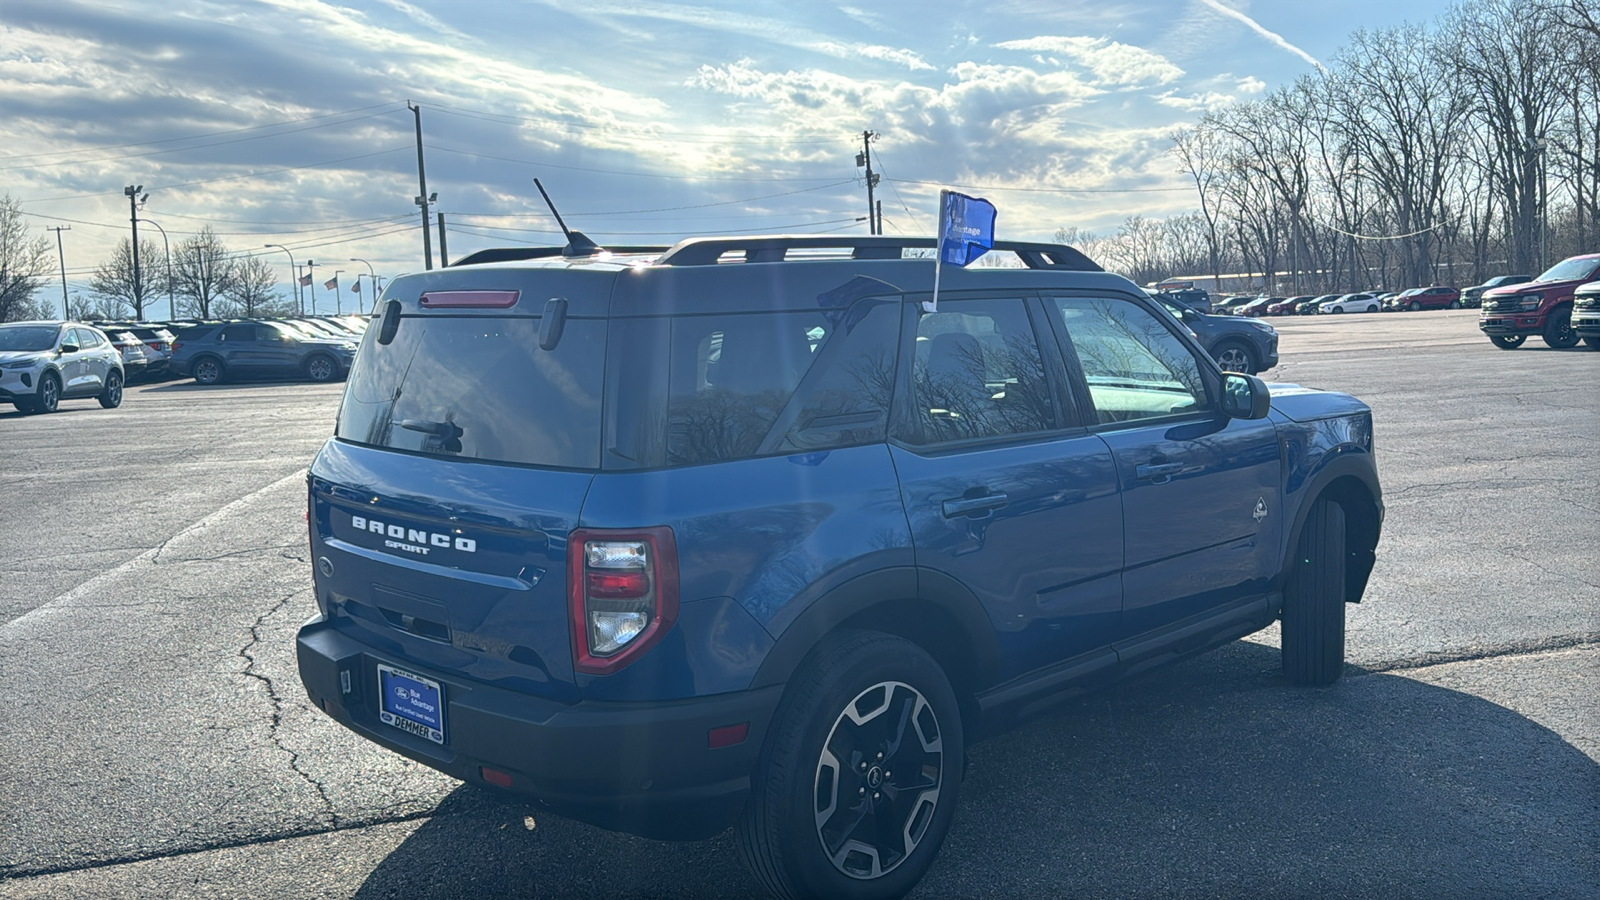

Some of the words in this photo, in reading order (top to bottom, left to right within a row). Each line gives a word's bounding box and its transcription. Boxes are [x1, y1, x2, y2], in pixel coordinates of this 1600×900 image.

[352, 515, 477, 553] BRONCO
[384, 539, 431, 555] SPORT
[394, 716, 430, 739] DEMMER
